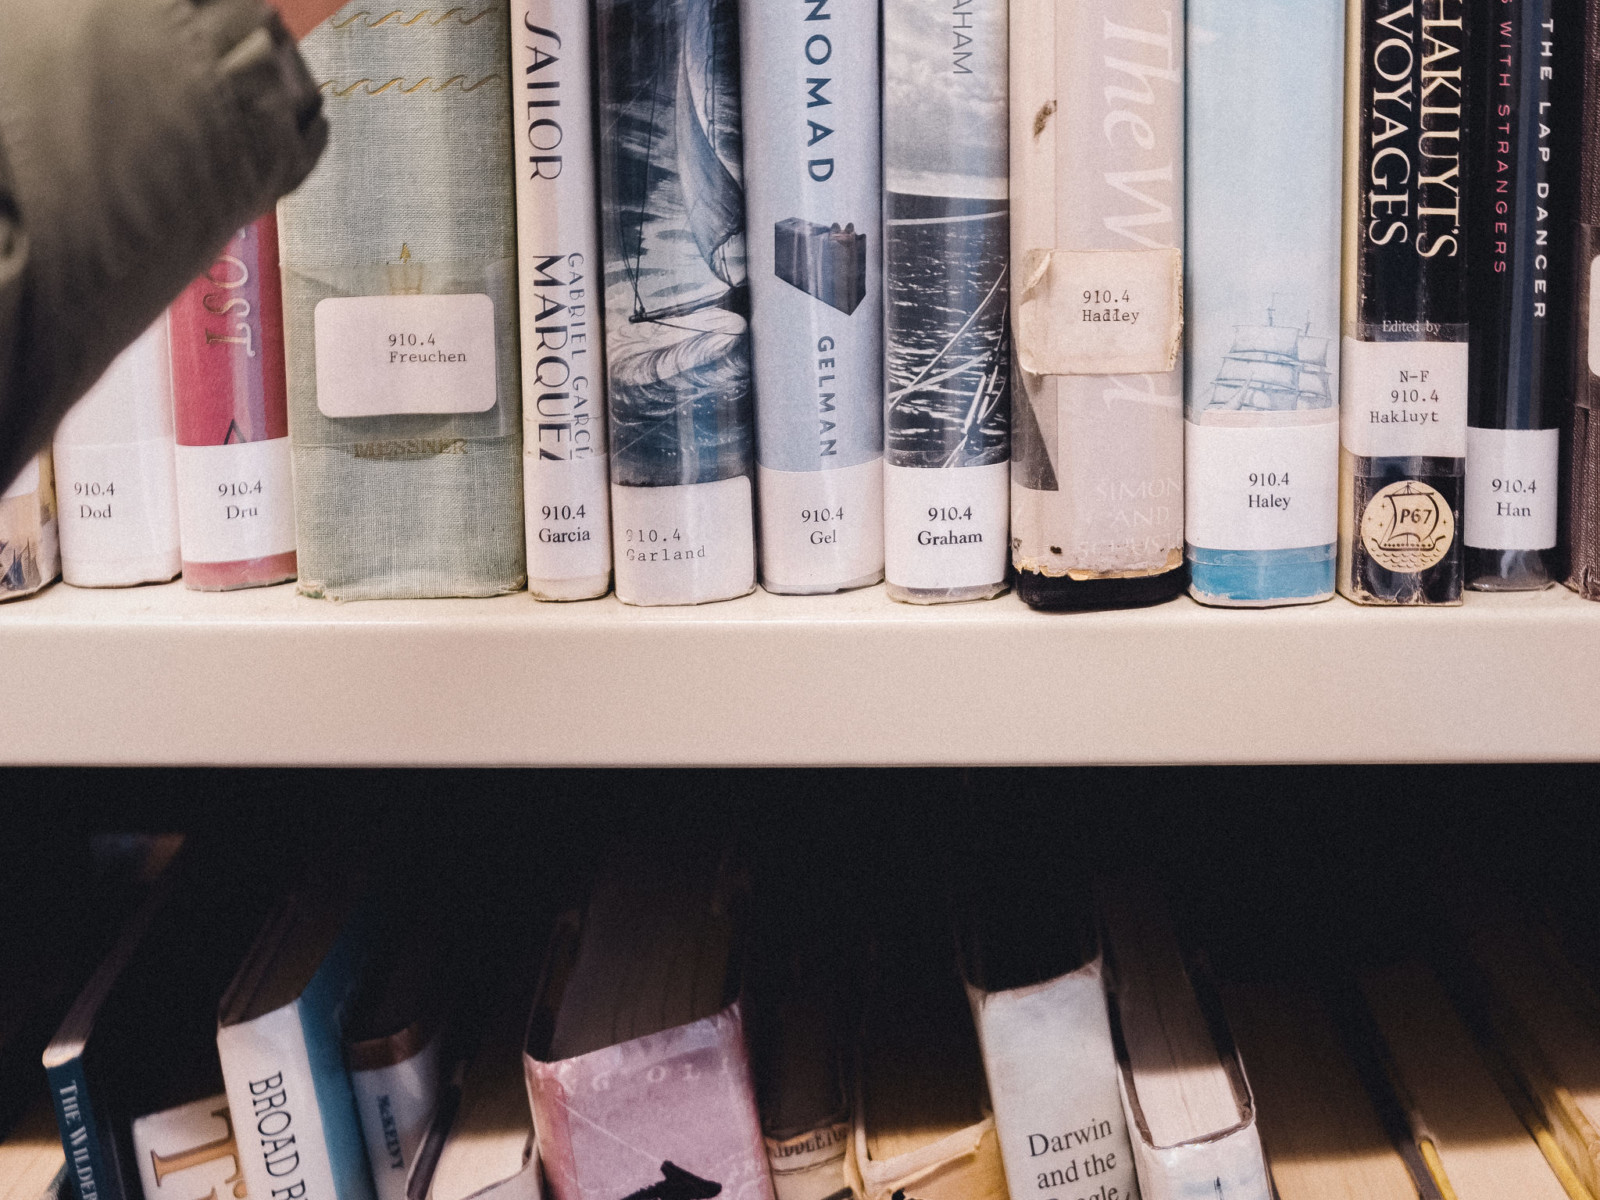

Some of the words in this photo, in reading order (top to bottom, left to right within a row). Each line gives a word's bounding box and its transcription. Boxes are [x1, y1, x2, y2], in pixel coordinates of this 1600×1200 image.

[1498, 21, 1513, 87] WITH
[1540, 18, 1555, 81] THE
[1102, 9, 1181, 151] The
[523, 10, 564, 181] SAILOR
[1368, 0, 1414, 246] VOYAGES
[1538, 101, 1553, 163] LAP
[1494, 104, 1511, 274] STRANGERS
[1534, 182, 1550, 318] DANCER
[203, 228, 256, 357] OST
[1083, 289, 1131, 304] 910.4
[567, 252, 588, 360] GABRIEL
[1082, 308, 1140, 324] Hadley
[1382, 320, 1420, 333] Edited
[1426, 322, 1442, 336] by
[388, 333, 436, 347] 910.4
[389, 350, 467, 363] Freuchen
[1399, 370, 1430, 383] N-F
[816, 335, 837, 457] GELMAN
[1390, 389, 1440, 403] 910.4
[1369, 410, 1440, 426] Hakluyt
[218, 479, 263, 497] 910.4
[1249, 472, 1290, 487] 910.4
[1491, 478, 1537, 494] 910.4
[74, 481, 116, 497] 910.4
[79, 503, 112, 519] Dod
[1248, 494, 1292, 511] Haley
[1496, 501, 1532, 517] Han
[225, 504, 259, 520] Dru
[541, 504, 586, 521] 910.4
[801, 507, 844, 523] 910.4
[927, 506, 973, 521] 910.4
[1400, 508, 1432, 525] P67
[538, 526, 591, 543] Garcia
[626, 528, 681, 543] 910.4
[810, 529, 837, 545] Gel
[917, 528, 983, 546] Graham
[626, 545, 706, 562] Garland
[60, 1079, 82, 1126] THE
[249, 1071, 300, 1177] BROAD
[1027, 1118, 1113, 1157] Darwin
[1037, 1158, 1080, 1189] and
[1083, 1152, 1117, 1178] the
